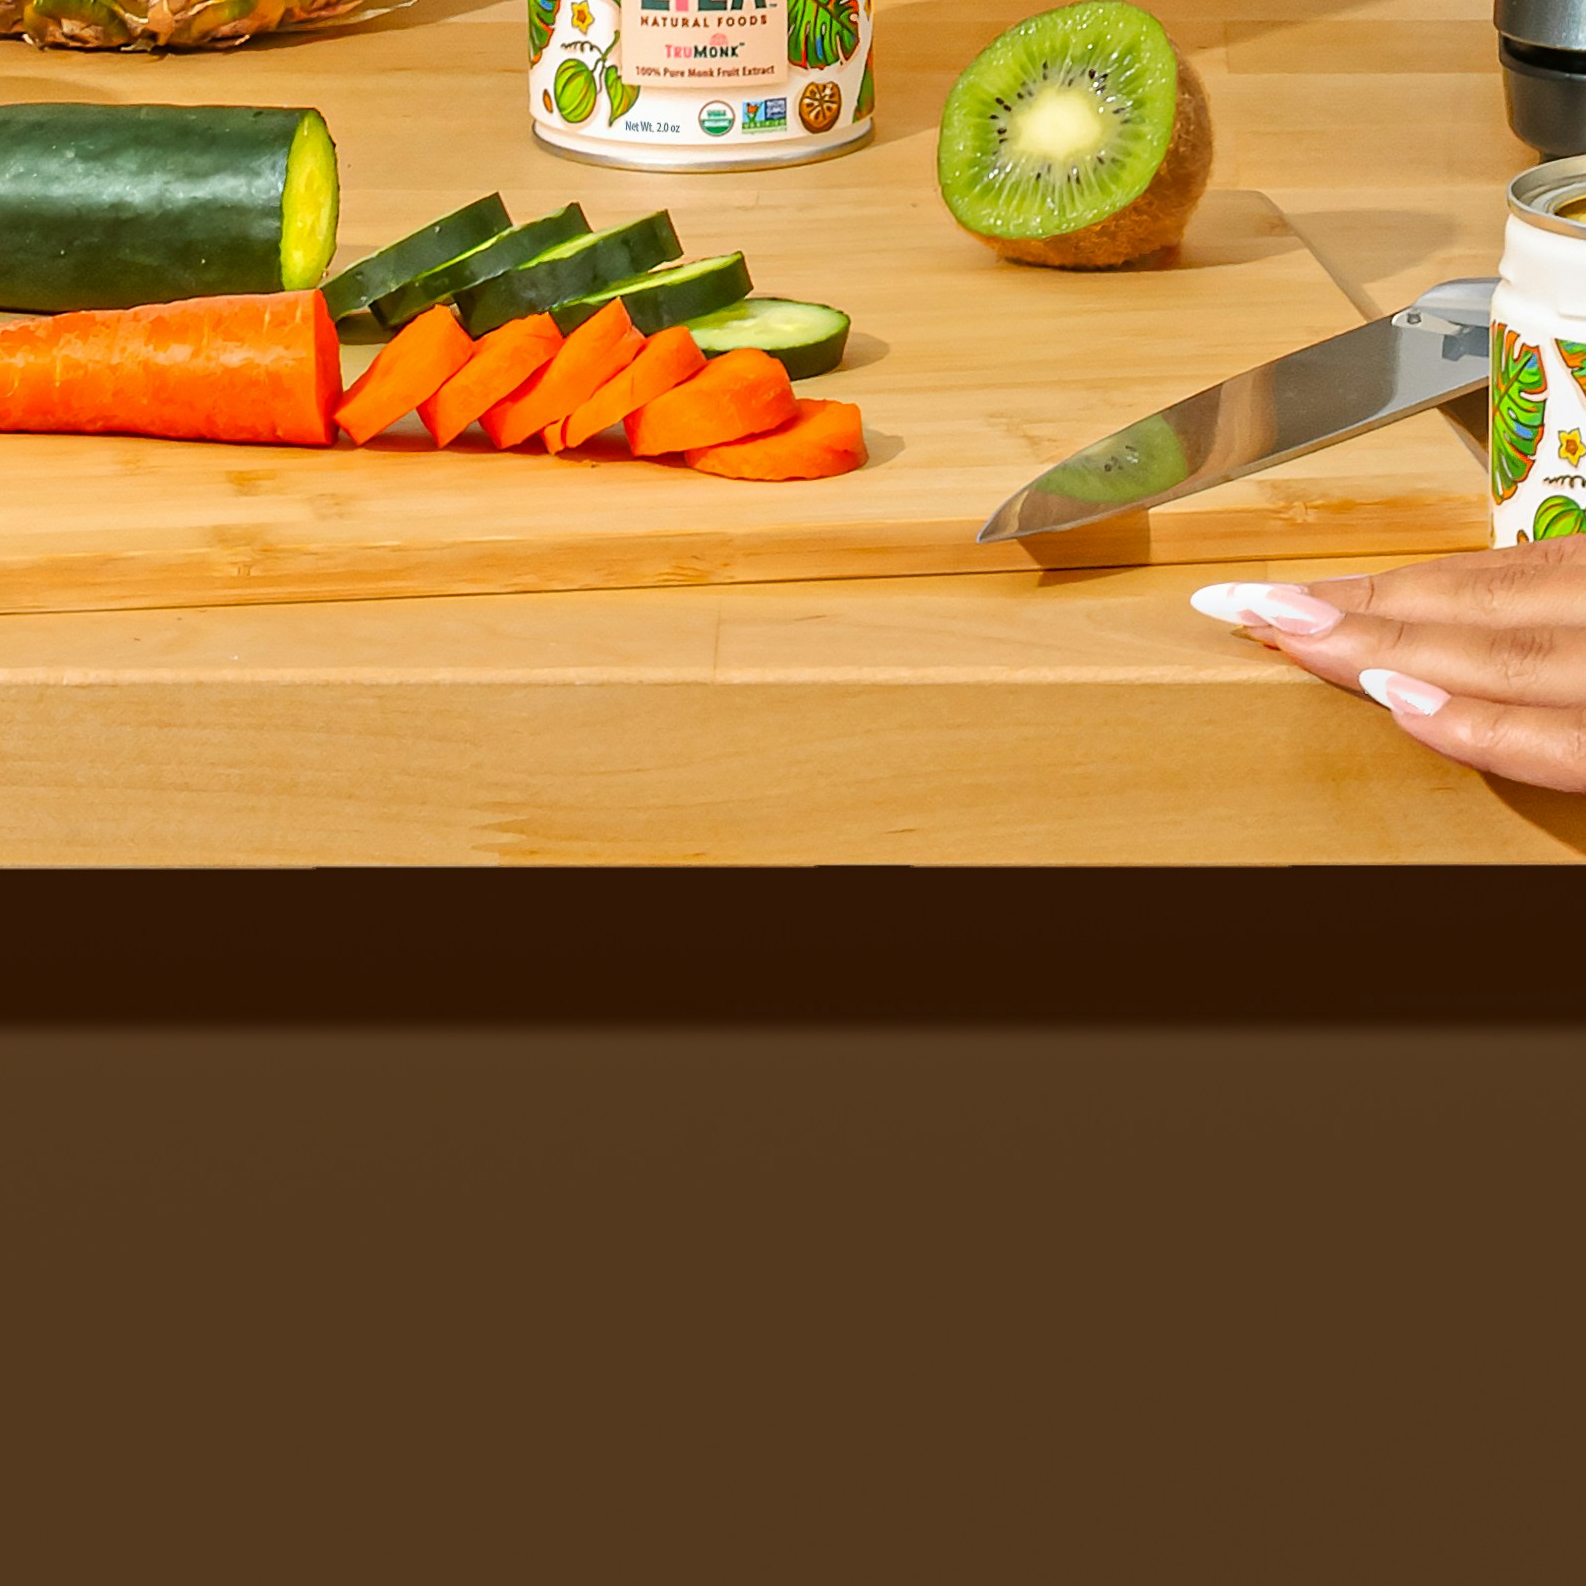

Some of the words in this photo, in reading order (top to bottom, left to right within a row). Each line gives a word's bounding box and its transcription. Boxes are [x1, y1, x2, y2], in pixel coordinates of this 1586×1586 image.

[640, 15, 709, 28] NATURAL
[718, 14, 767, 27] FOODS
[636, 66, 661, 76] 100%
[663, 67, 684, 77] Pure
[687, 67, 713, 77] Monk
[717, 66, 739, 77] Fruit
[742, 64, 775, 76] Extract
[625, 121, 639, 132] Net
[640, 122, 654, 133] Wt.
[656, 122, 669, 133] 2.0
[670, 125, 680, 133] oz
